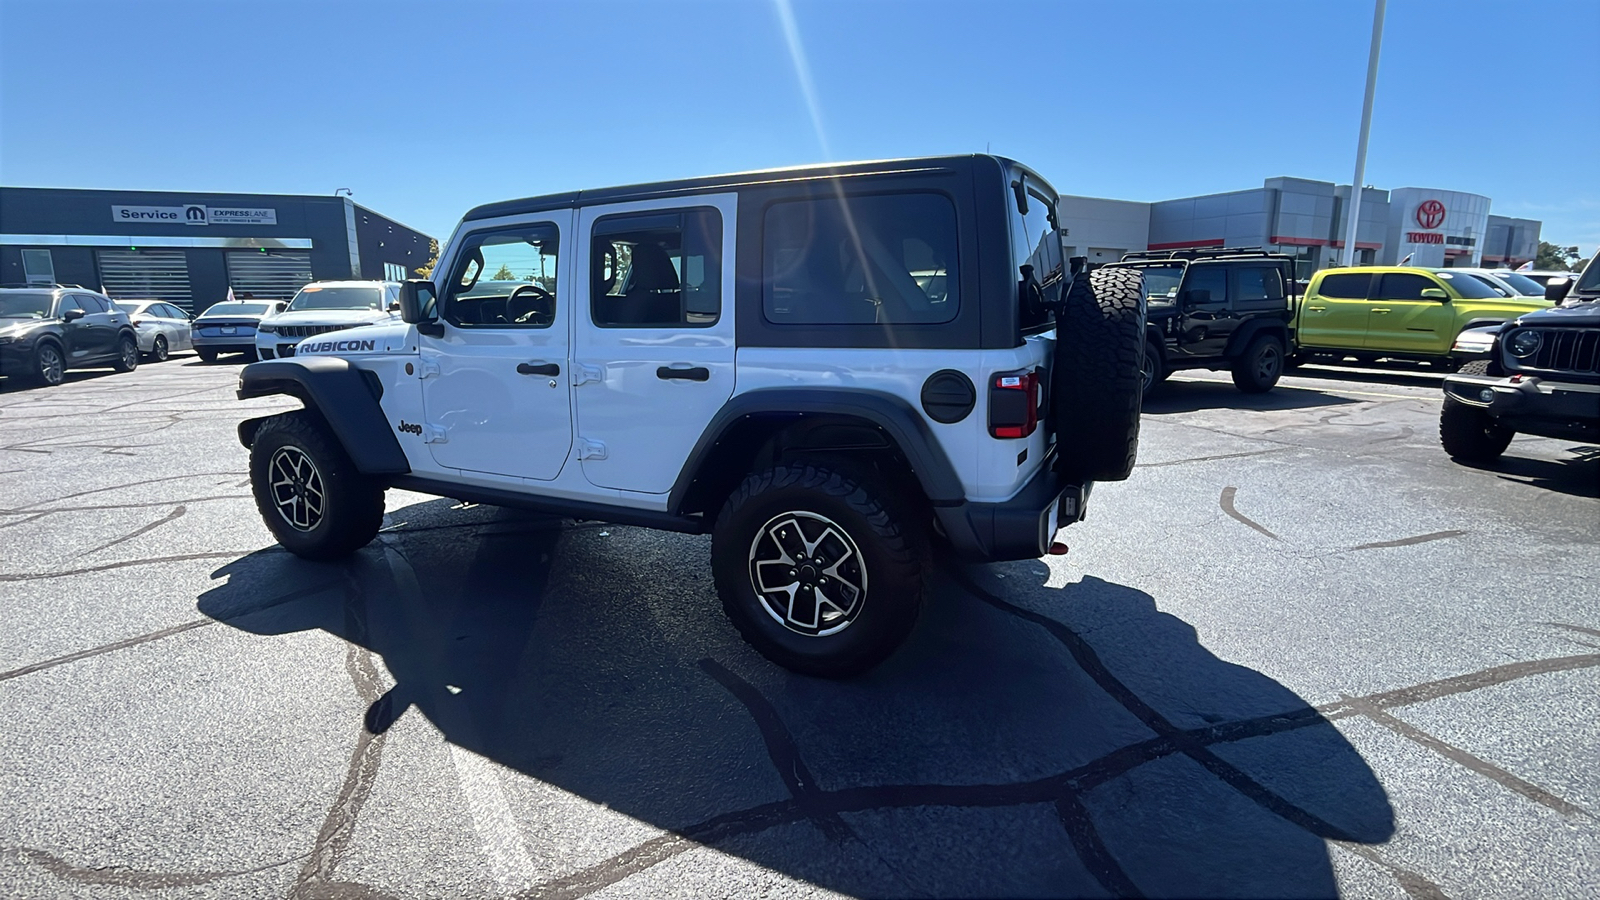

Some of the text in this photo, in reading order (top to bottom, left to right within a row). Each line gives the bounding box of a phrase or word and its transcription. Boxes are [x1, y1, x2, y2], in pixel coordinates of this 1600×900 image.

[121, 209, 178, 220] Service
[1407, 232, 1443, 244] TOYOTA
[300, 340, 375, 353] RUBICON
[398, 420, 422, 436] Jeep
